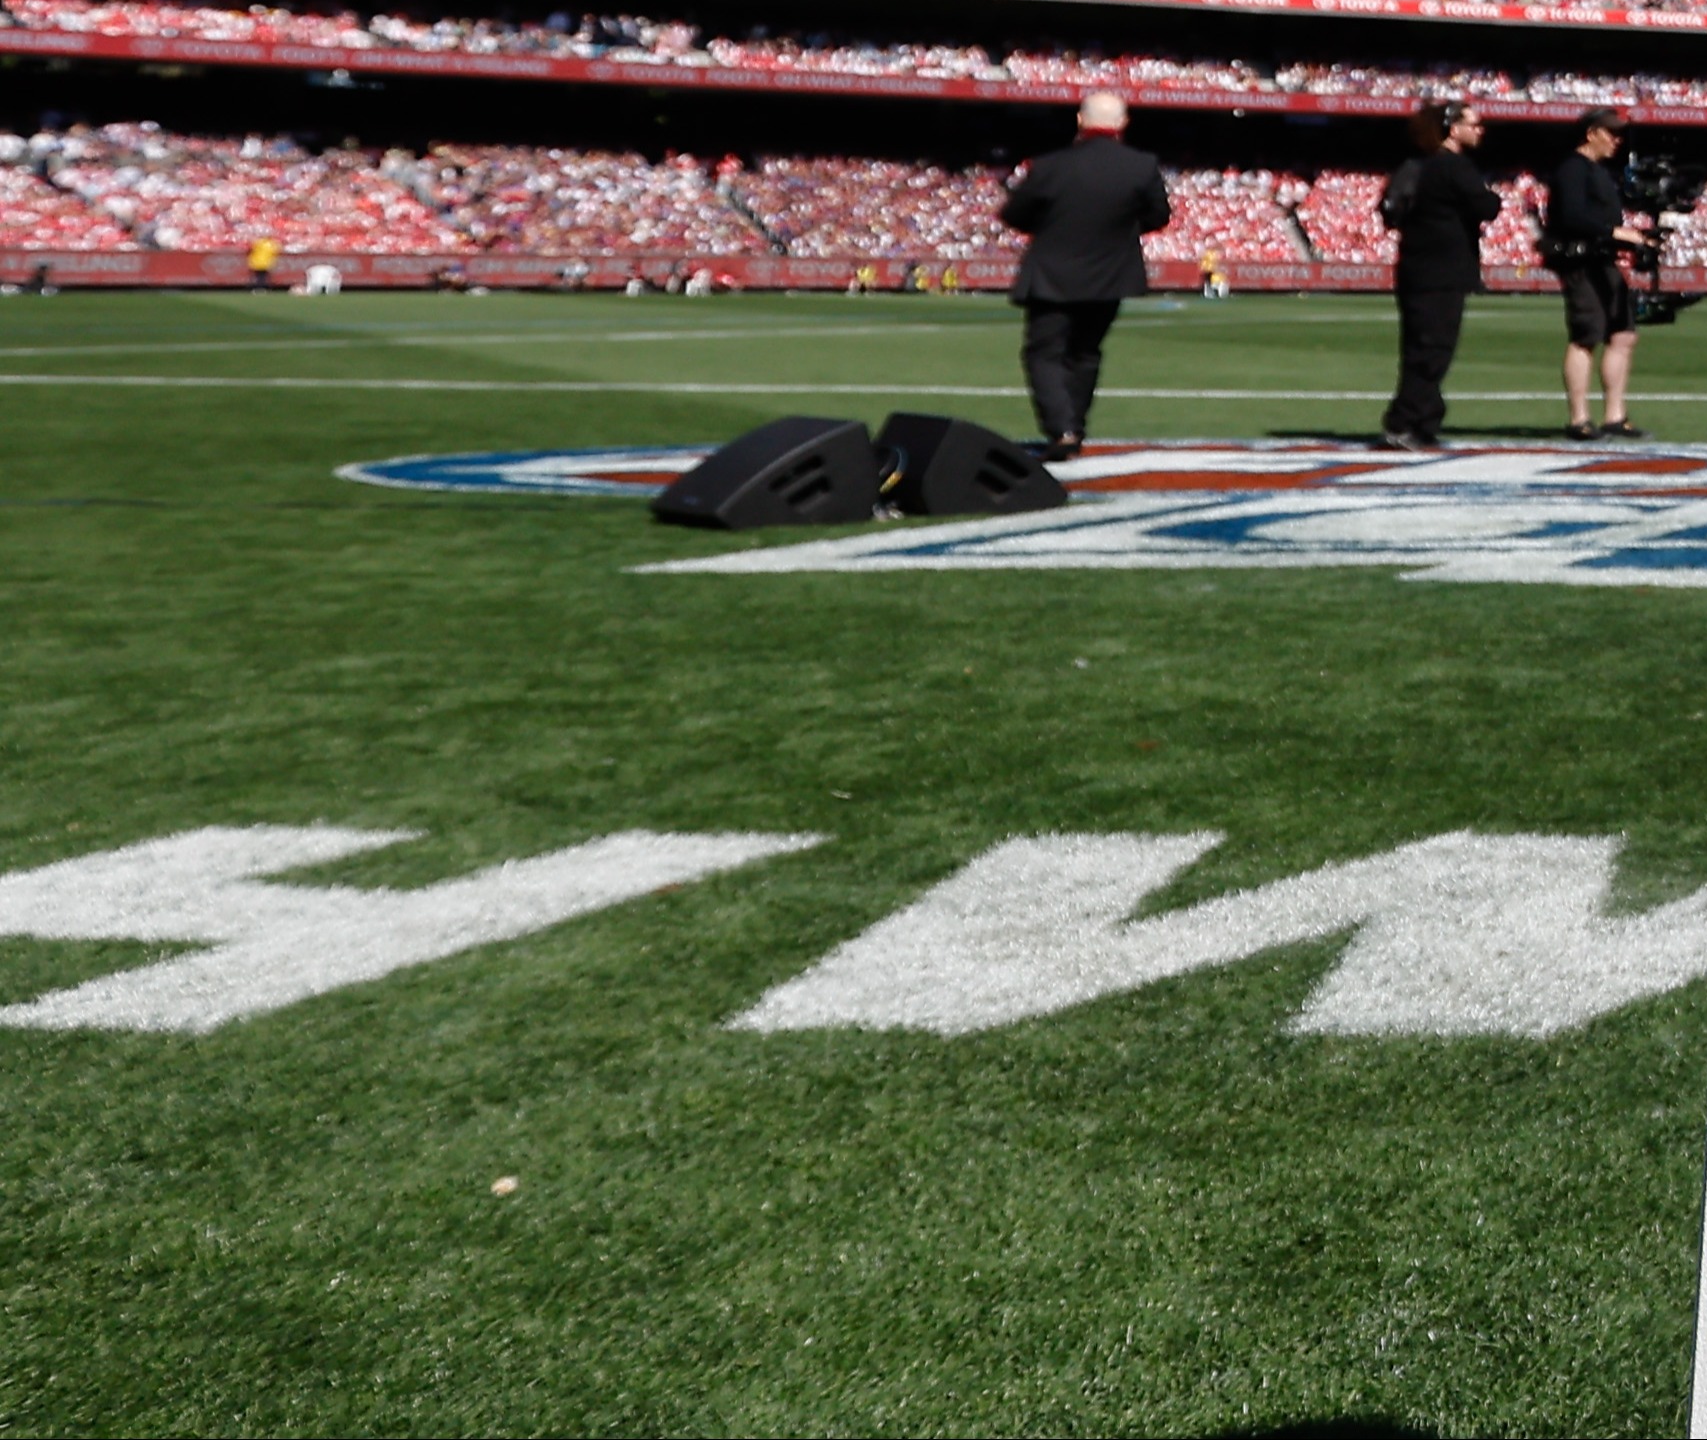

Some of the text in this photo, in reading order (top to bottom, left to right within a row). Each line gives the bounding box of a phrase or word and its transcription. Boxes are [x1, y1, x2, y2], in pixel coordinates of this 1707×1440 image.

[1444, 2, 1499, 18] TOYOTA
[1549, 8, 1603, 23] TOYOTA
[1650, 12, 1704, 27] TOYOTA
[1652, 109, 1705, 122] TOYOTA
